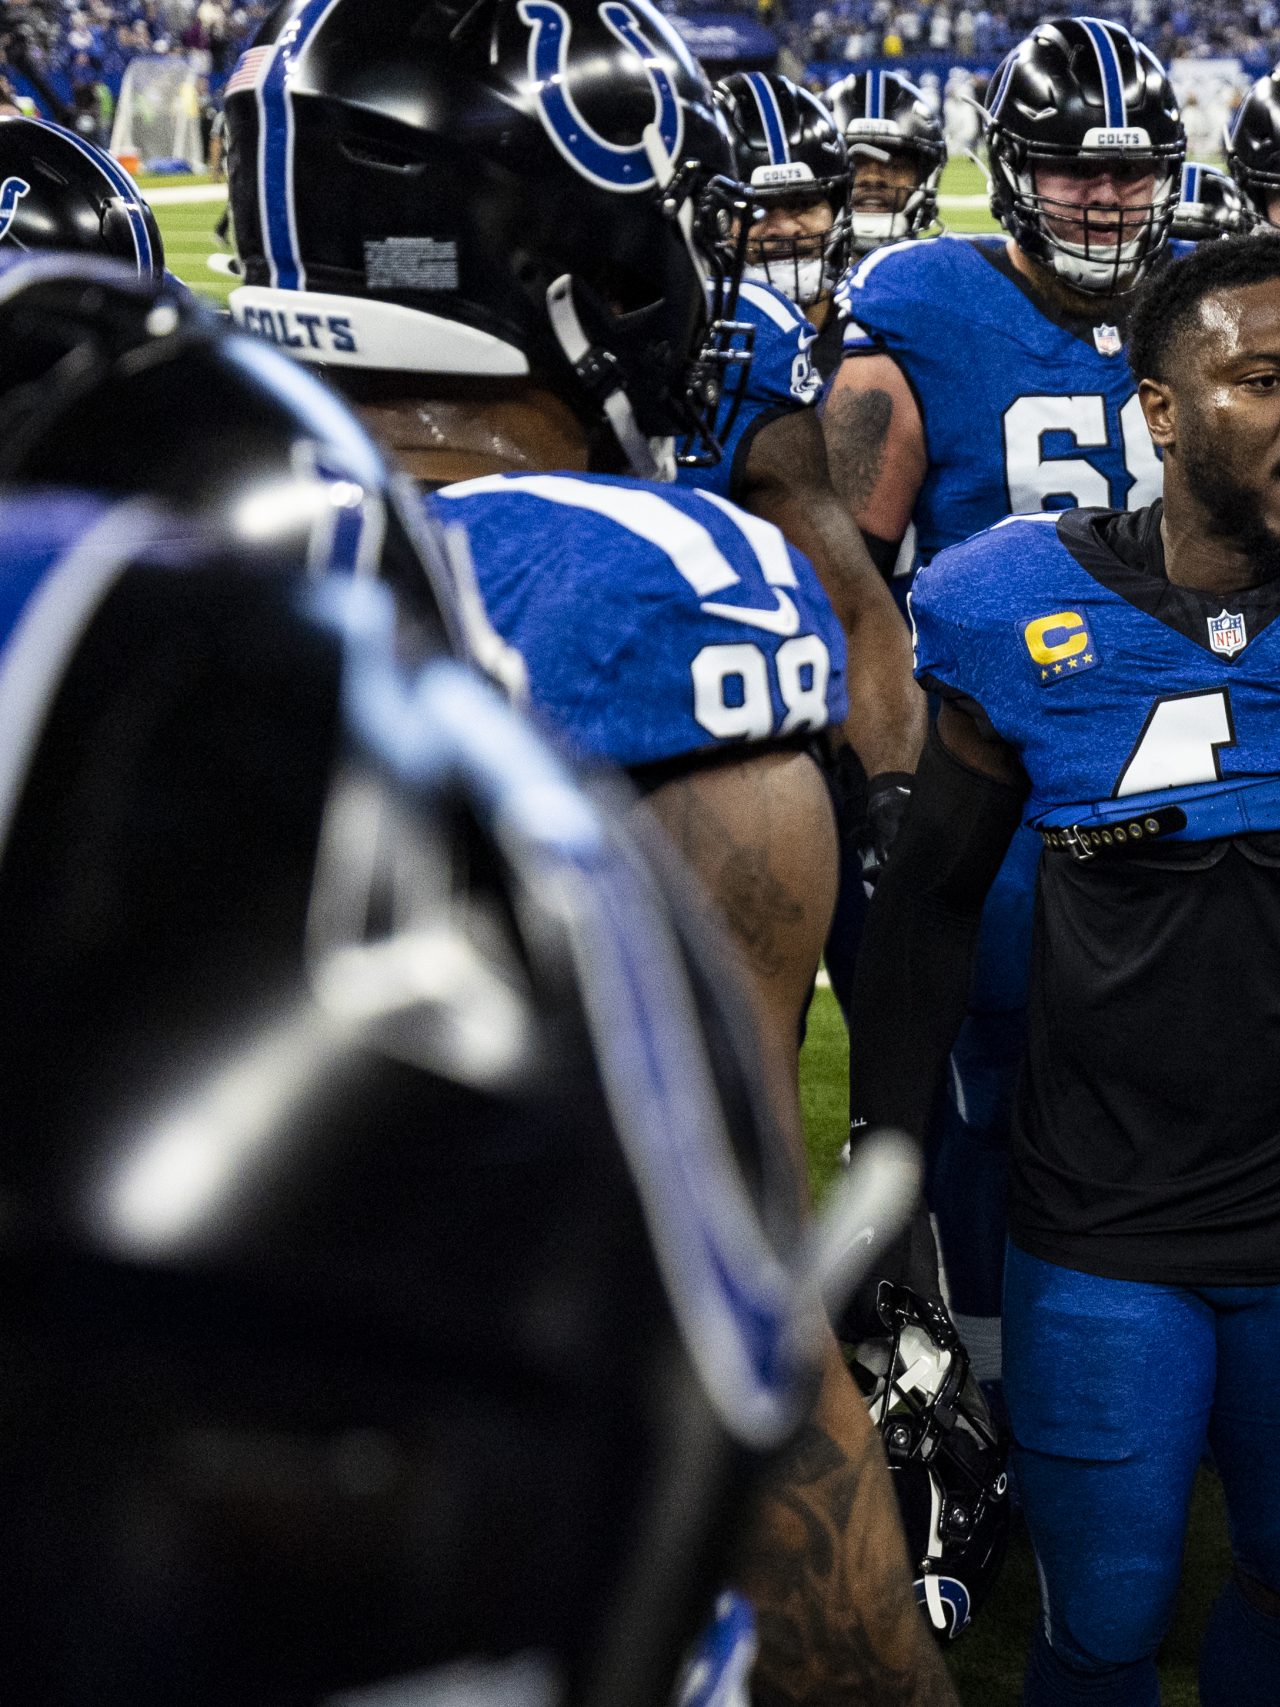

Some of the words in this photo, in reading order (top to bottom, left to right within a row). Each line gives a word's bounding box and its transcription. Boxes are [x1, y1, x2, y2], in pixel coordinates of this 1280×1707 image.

[1098, 133, 1140, 145] COLTS
[764, 169, 802, 181] COLTS
[242, 306, 357, 351] COLTS
[1024, 611, 1088, 664] C
[1216, 630, 1241, 647] NFL
[691, 634, 829, 741] 98
